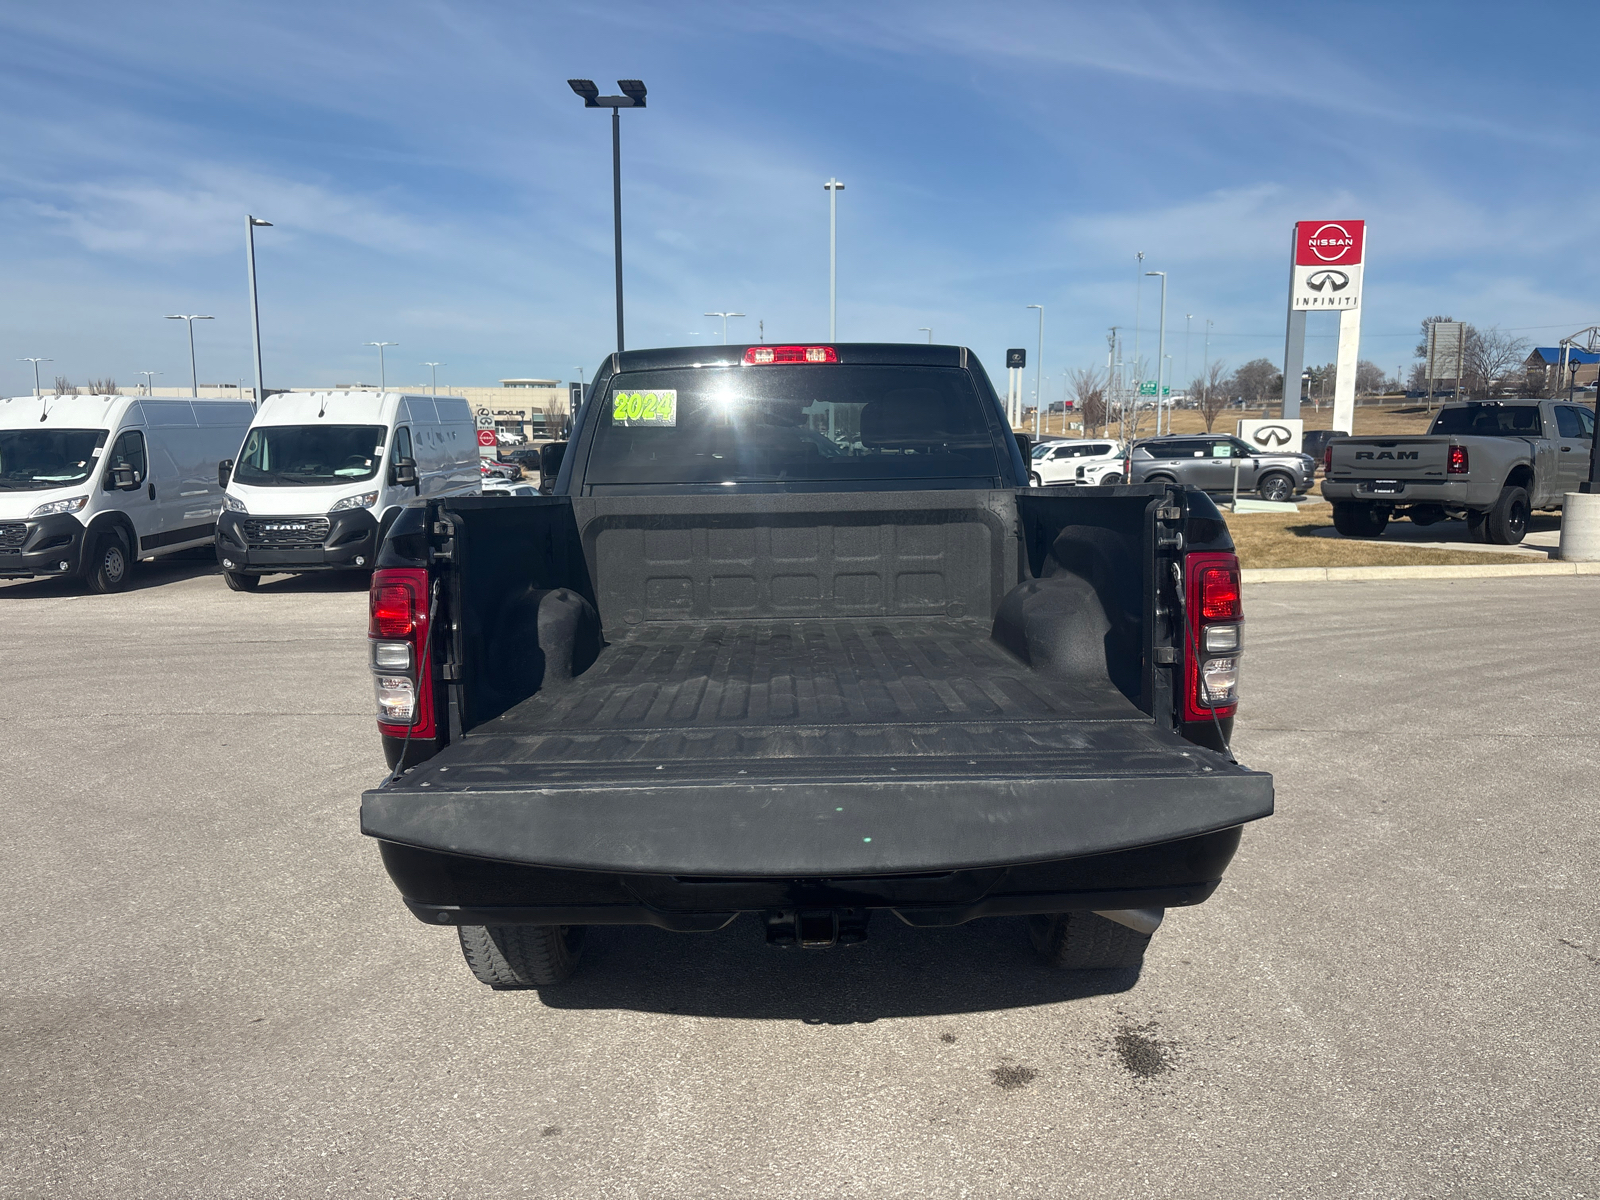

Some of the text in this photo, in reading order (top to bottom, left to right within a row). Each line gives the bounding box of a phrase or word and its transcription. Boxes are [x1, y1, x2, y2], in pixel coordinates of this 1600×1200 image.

[1308, 238, 1353, 246] NISSAN
[1296, 297, 1357, 306] INFINITI
[613, 392, 673, 421] 2024
[1355, 451, 1419, 460] RAM
